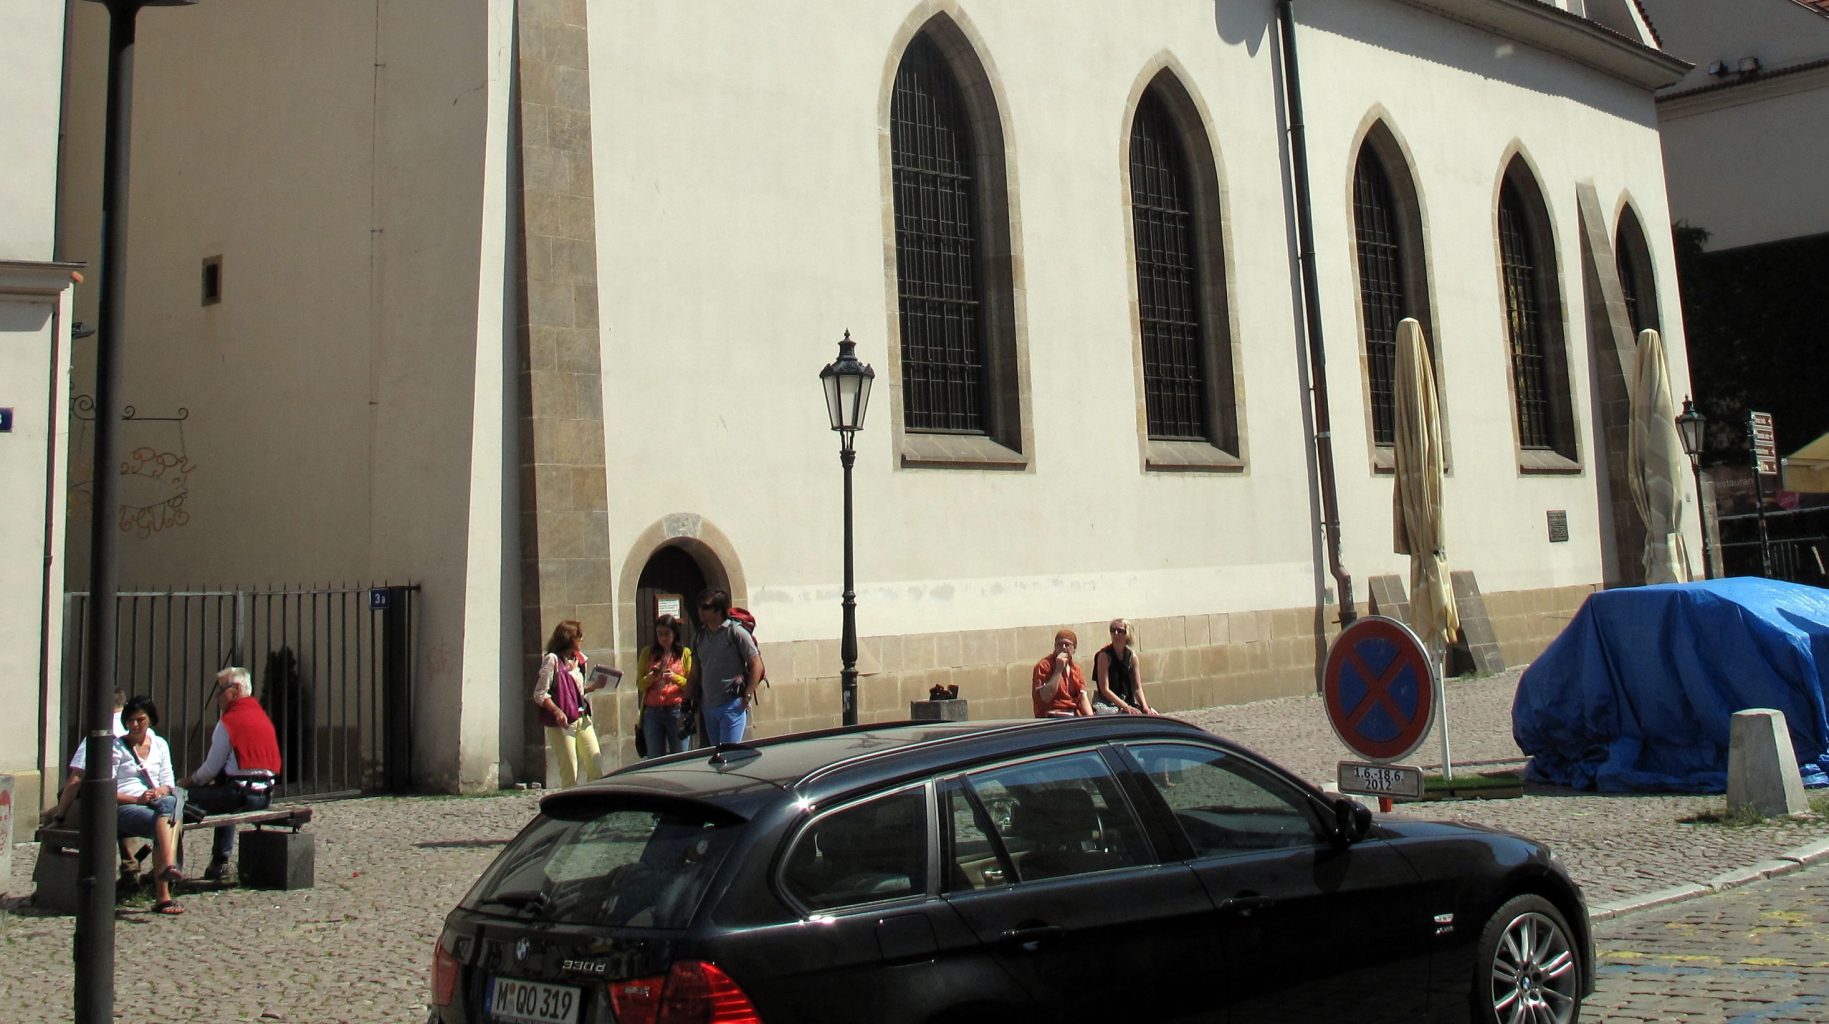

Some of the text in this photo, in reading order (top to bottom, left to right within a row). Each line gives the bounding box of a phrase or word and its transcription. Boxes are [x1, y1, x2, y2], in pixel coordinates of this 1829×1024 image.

[1354, 766, 1404, 782] 1.6.-18.6.
[1365, 778, 1392, 791] 2012
[562, 960, 606, 973] 330d
[496, 980, 509, 1012] M
[540, 987, 572, 1021] 319
